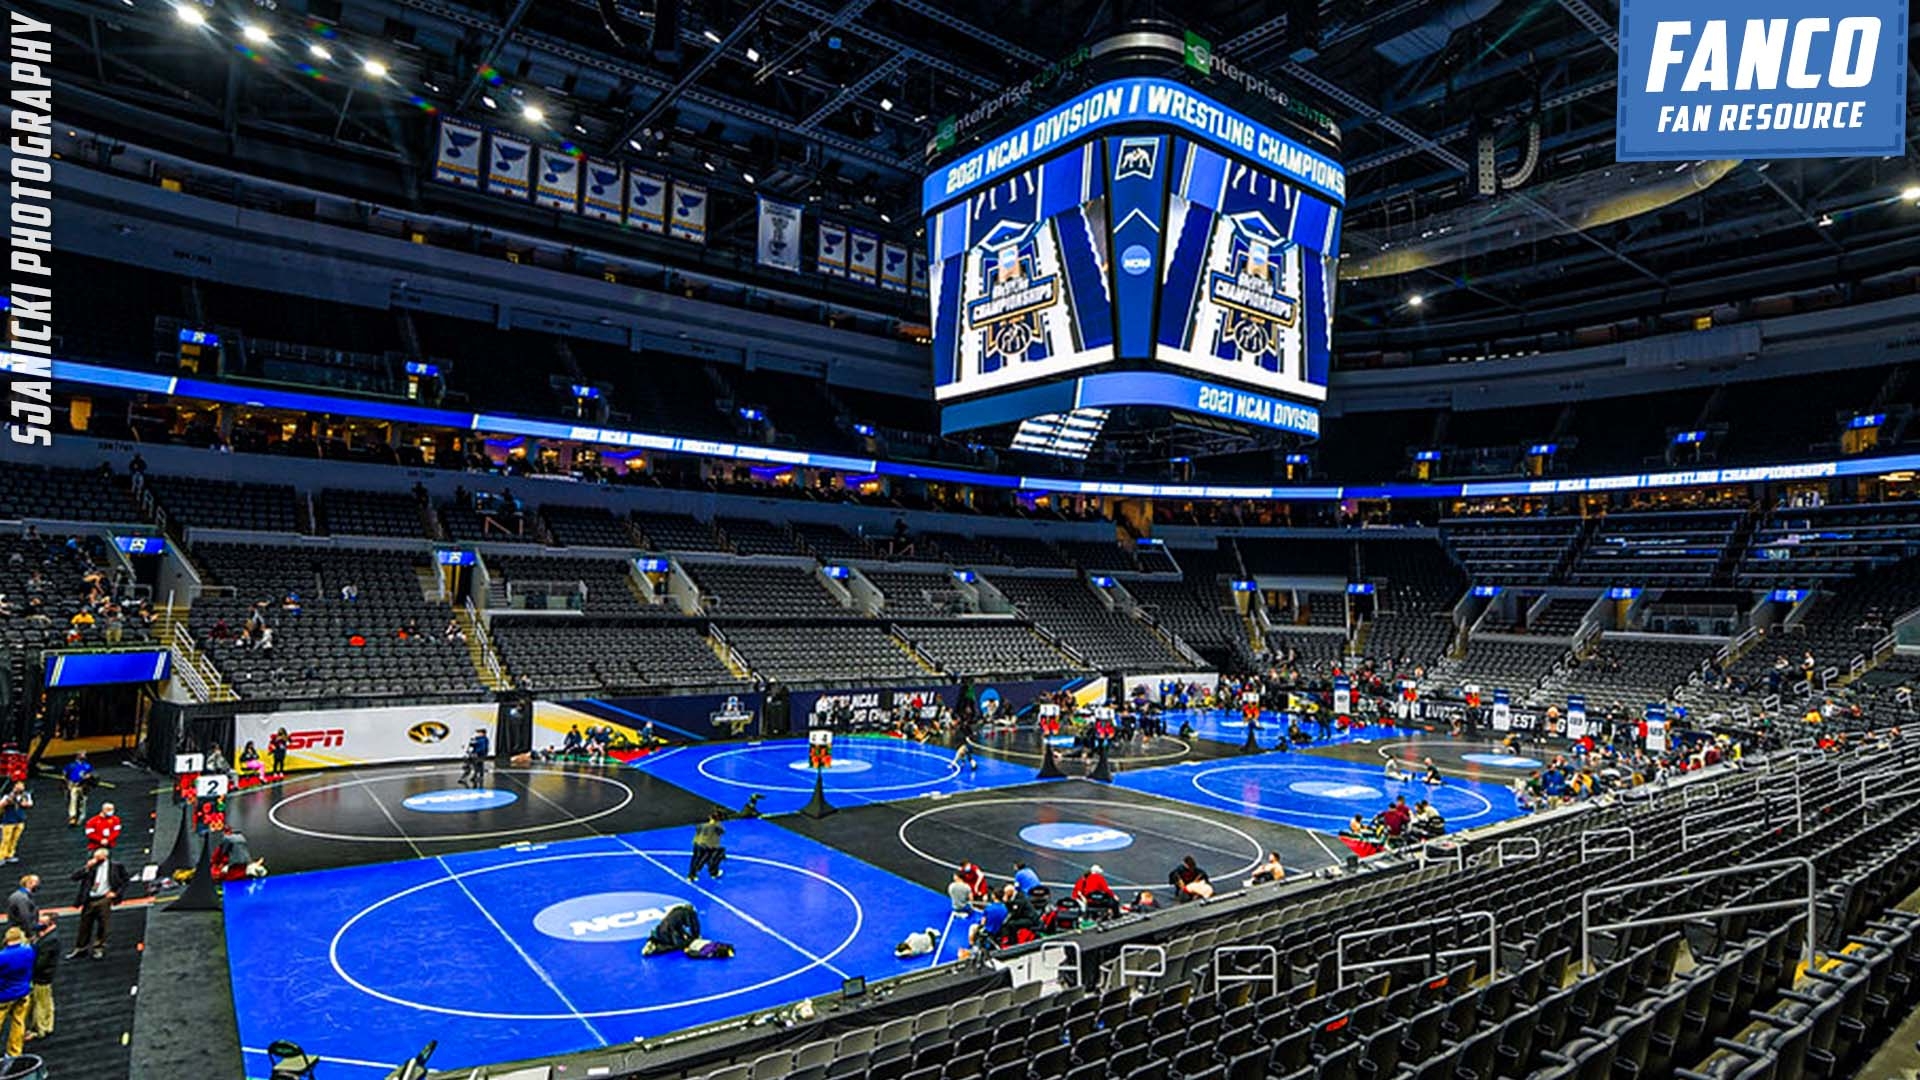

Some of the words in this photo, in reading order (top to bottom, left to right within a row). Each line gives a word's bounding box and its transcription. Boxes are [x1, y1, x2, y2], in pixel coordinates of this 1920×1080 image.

[1187, 45, 1289, 107] enterprise
[946, 153, 983, 194] 2021
[985, 130, 1028, 176] NCAA
[1032, 86, 1124, 152] DIVISION
[1128, 85, 1141, 113] I
[1148, 85, 1256, 152] WRESTLING
[1198, 385, 1233, 414] 2021
[1236, 394, 1271, 423] NCAA
[1721, 463, 1836, 482] CHAMPIONSHIPS
[185, 757, 193, 771] 1
[207, 780, 219, 796] 2
